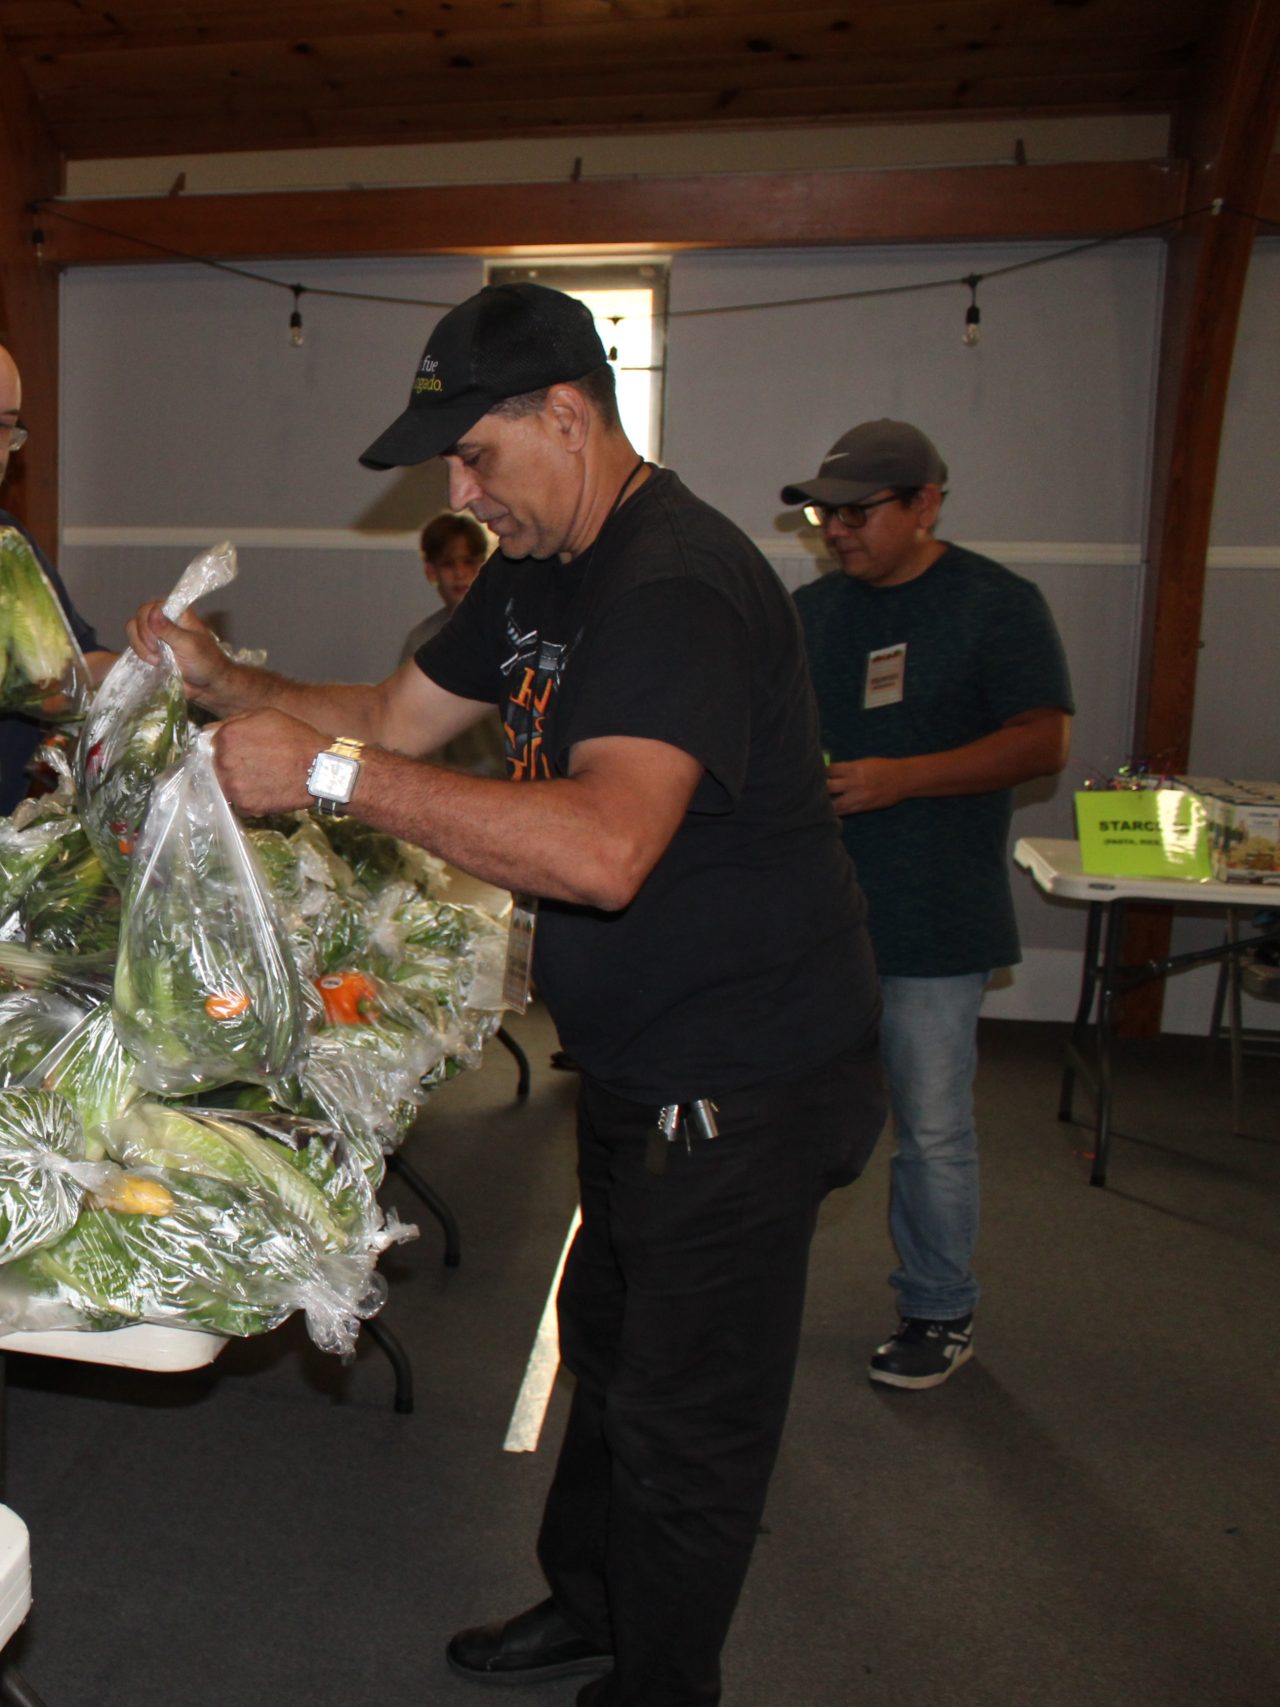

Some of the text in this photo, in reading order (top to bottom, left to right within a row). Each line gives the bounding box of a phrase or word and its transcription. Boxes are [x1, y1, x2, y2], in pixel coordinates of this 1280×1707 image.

[422, 355, 439, 372] fue
[414, 374, 443, 394] gado.
[1099, 820, 1189, 834] STARC
